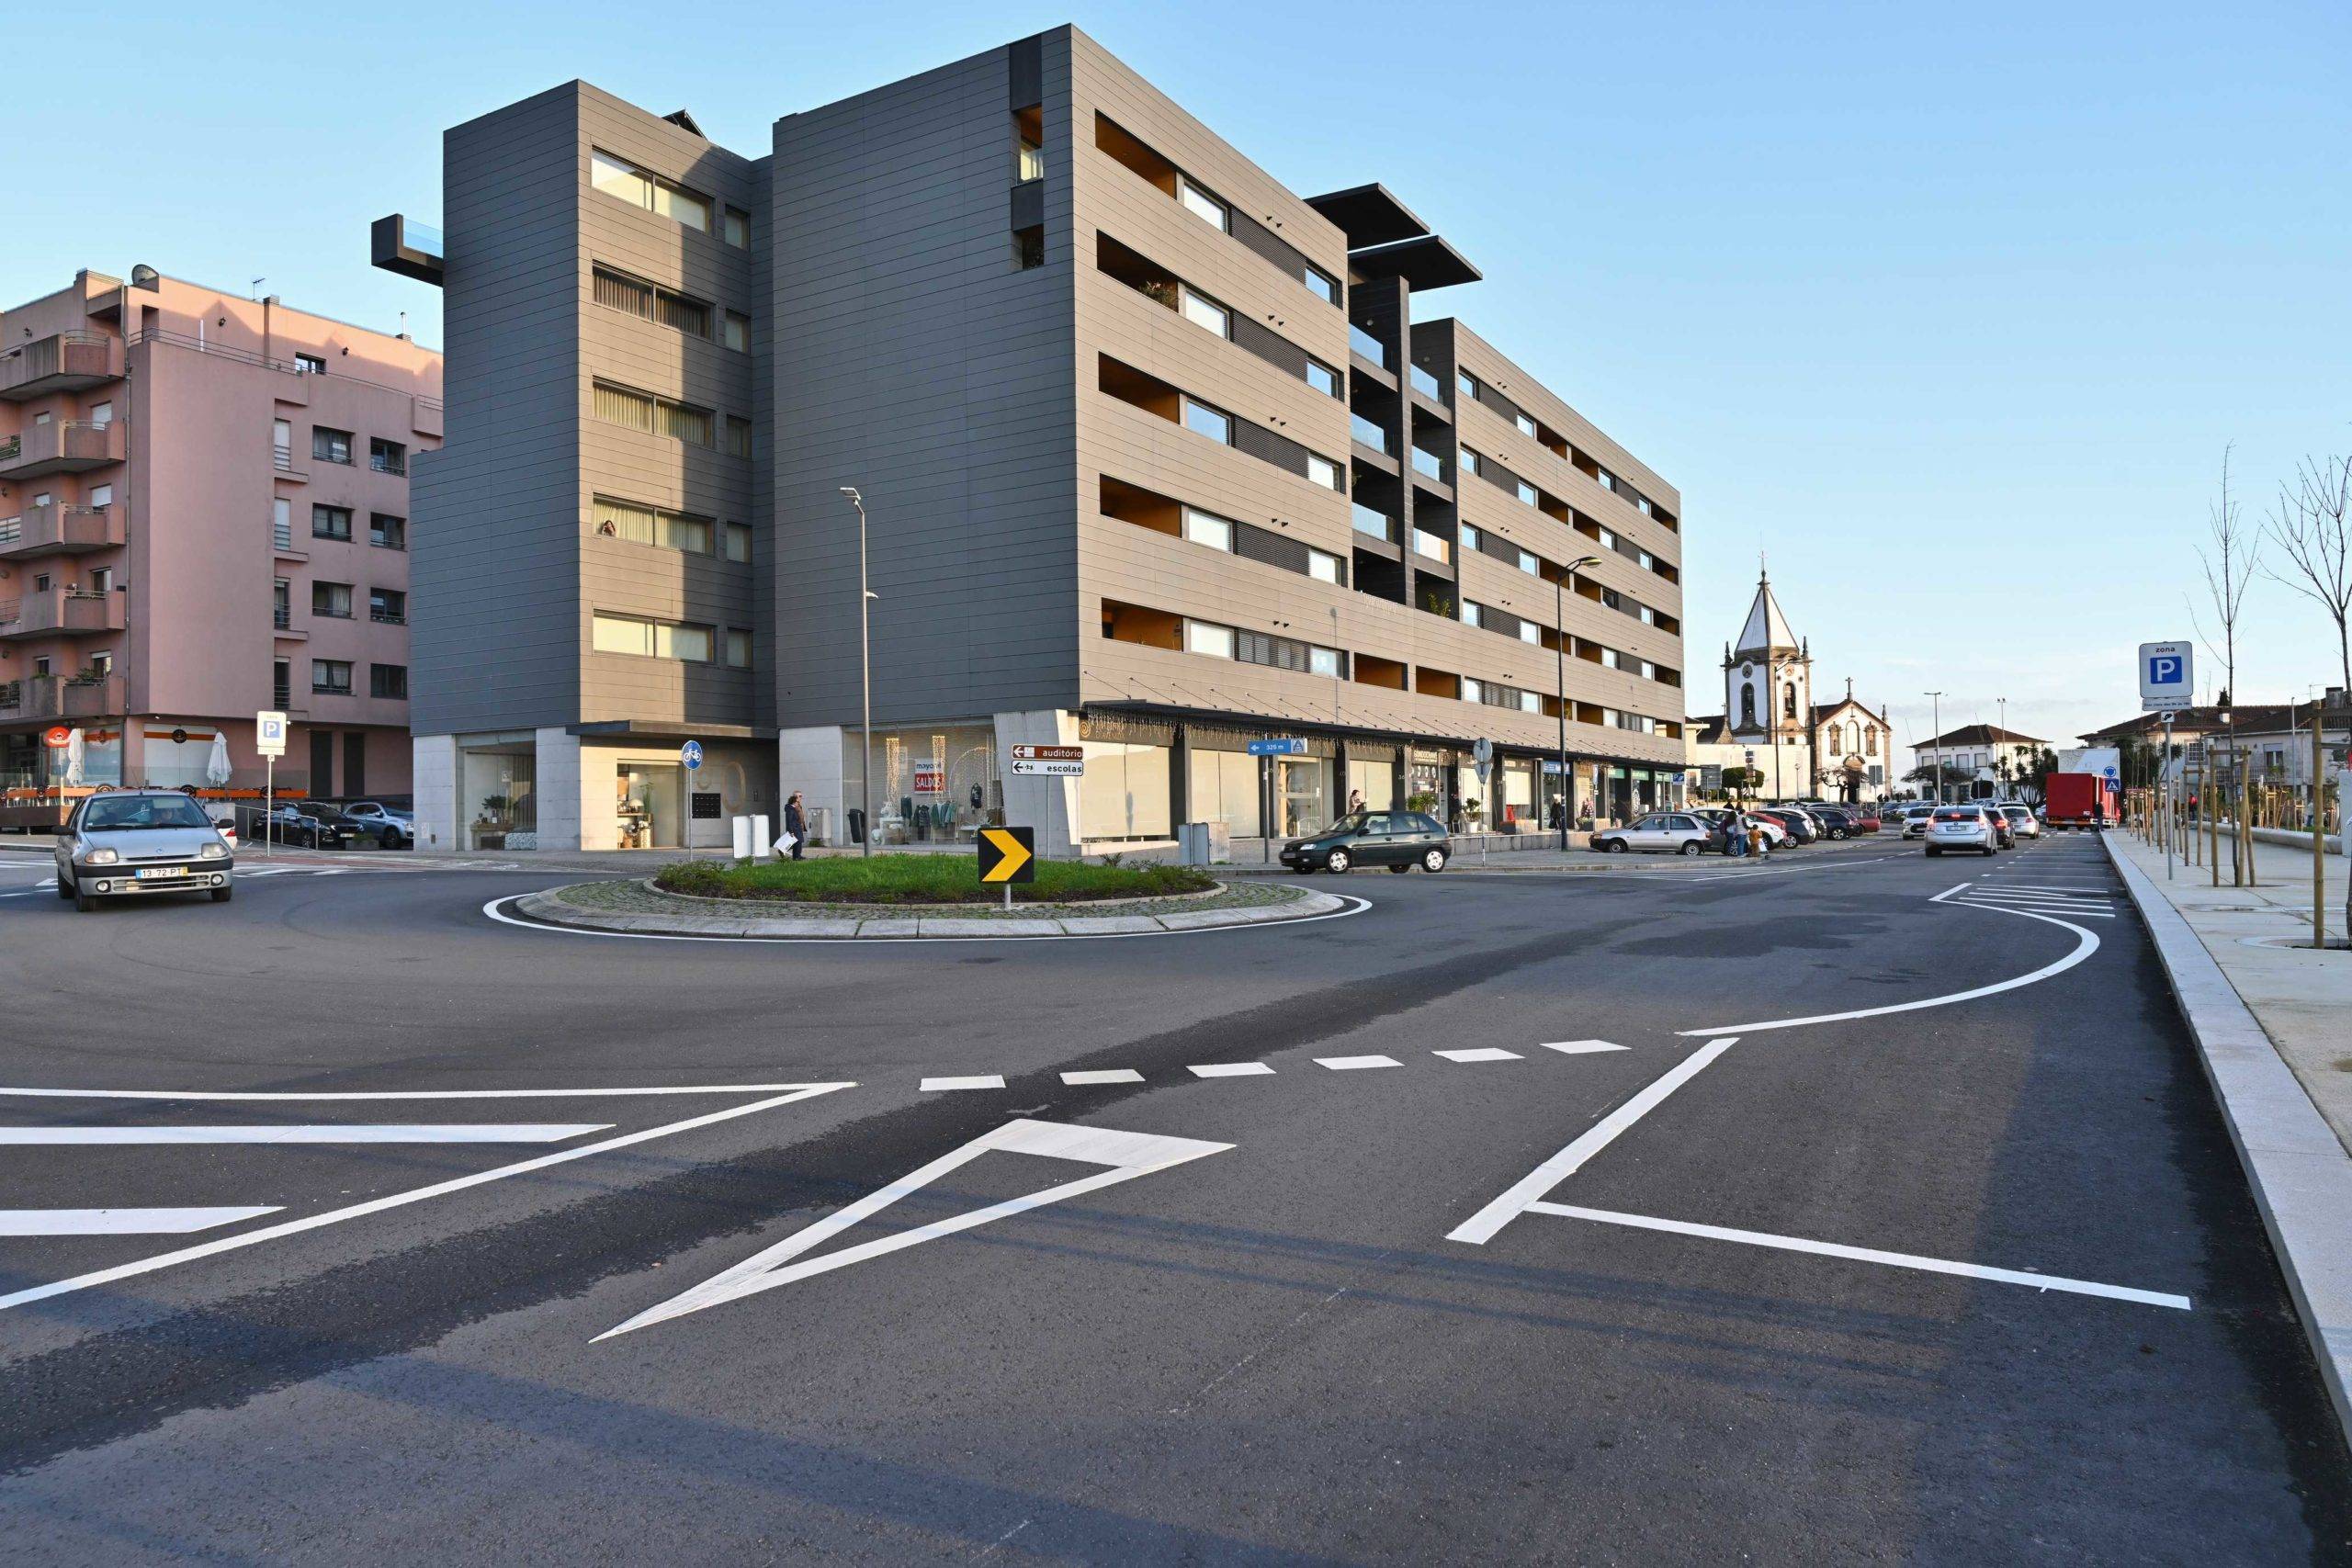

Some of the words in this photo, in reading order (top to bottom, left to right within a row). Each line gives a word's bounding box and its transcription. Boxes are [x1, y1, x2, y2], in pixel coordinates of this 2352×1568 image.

[2156, 659, 2176, 682] P
[266, 722, 277, 737] P
[1042, 749, 1082, 758] auditório
[1046, 764, 1082, 773] escolas
